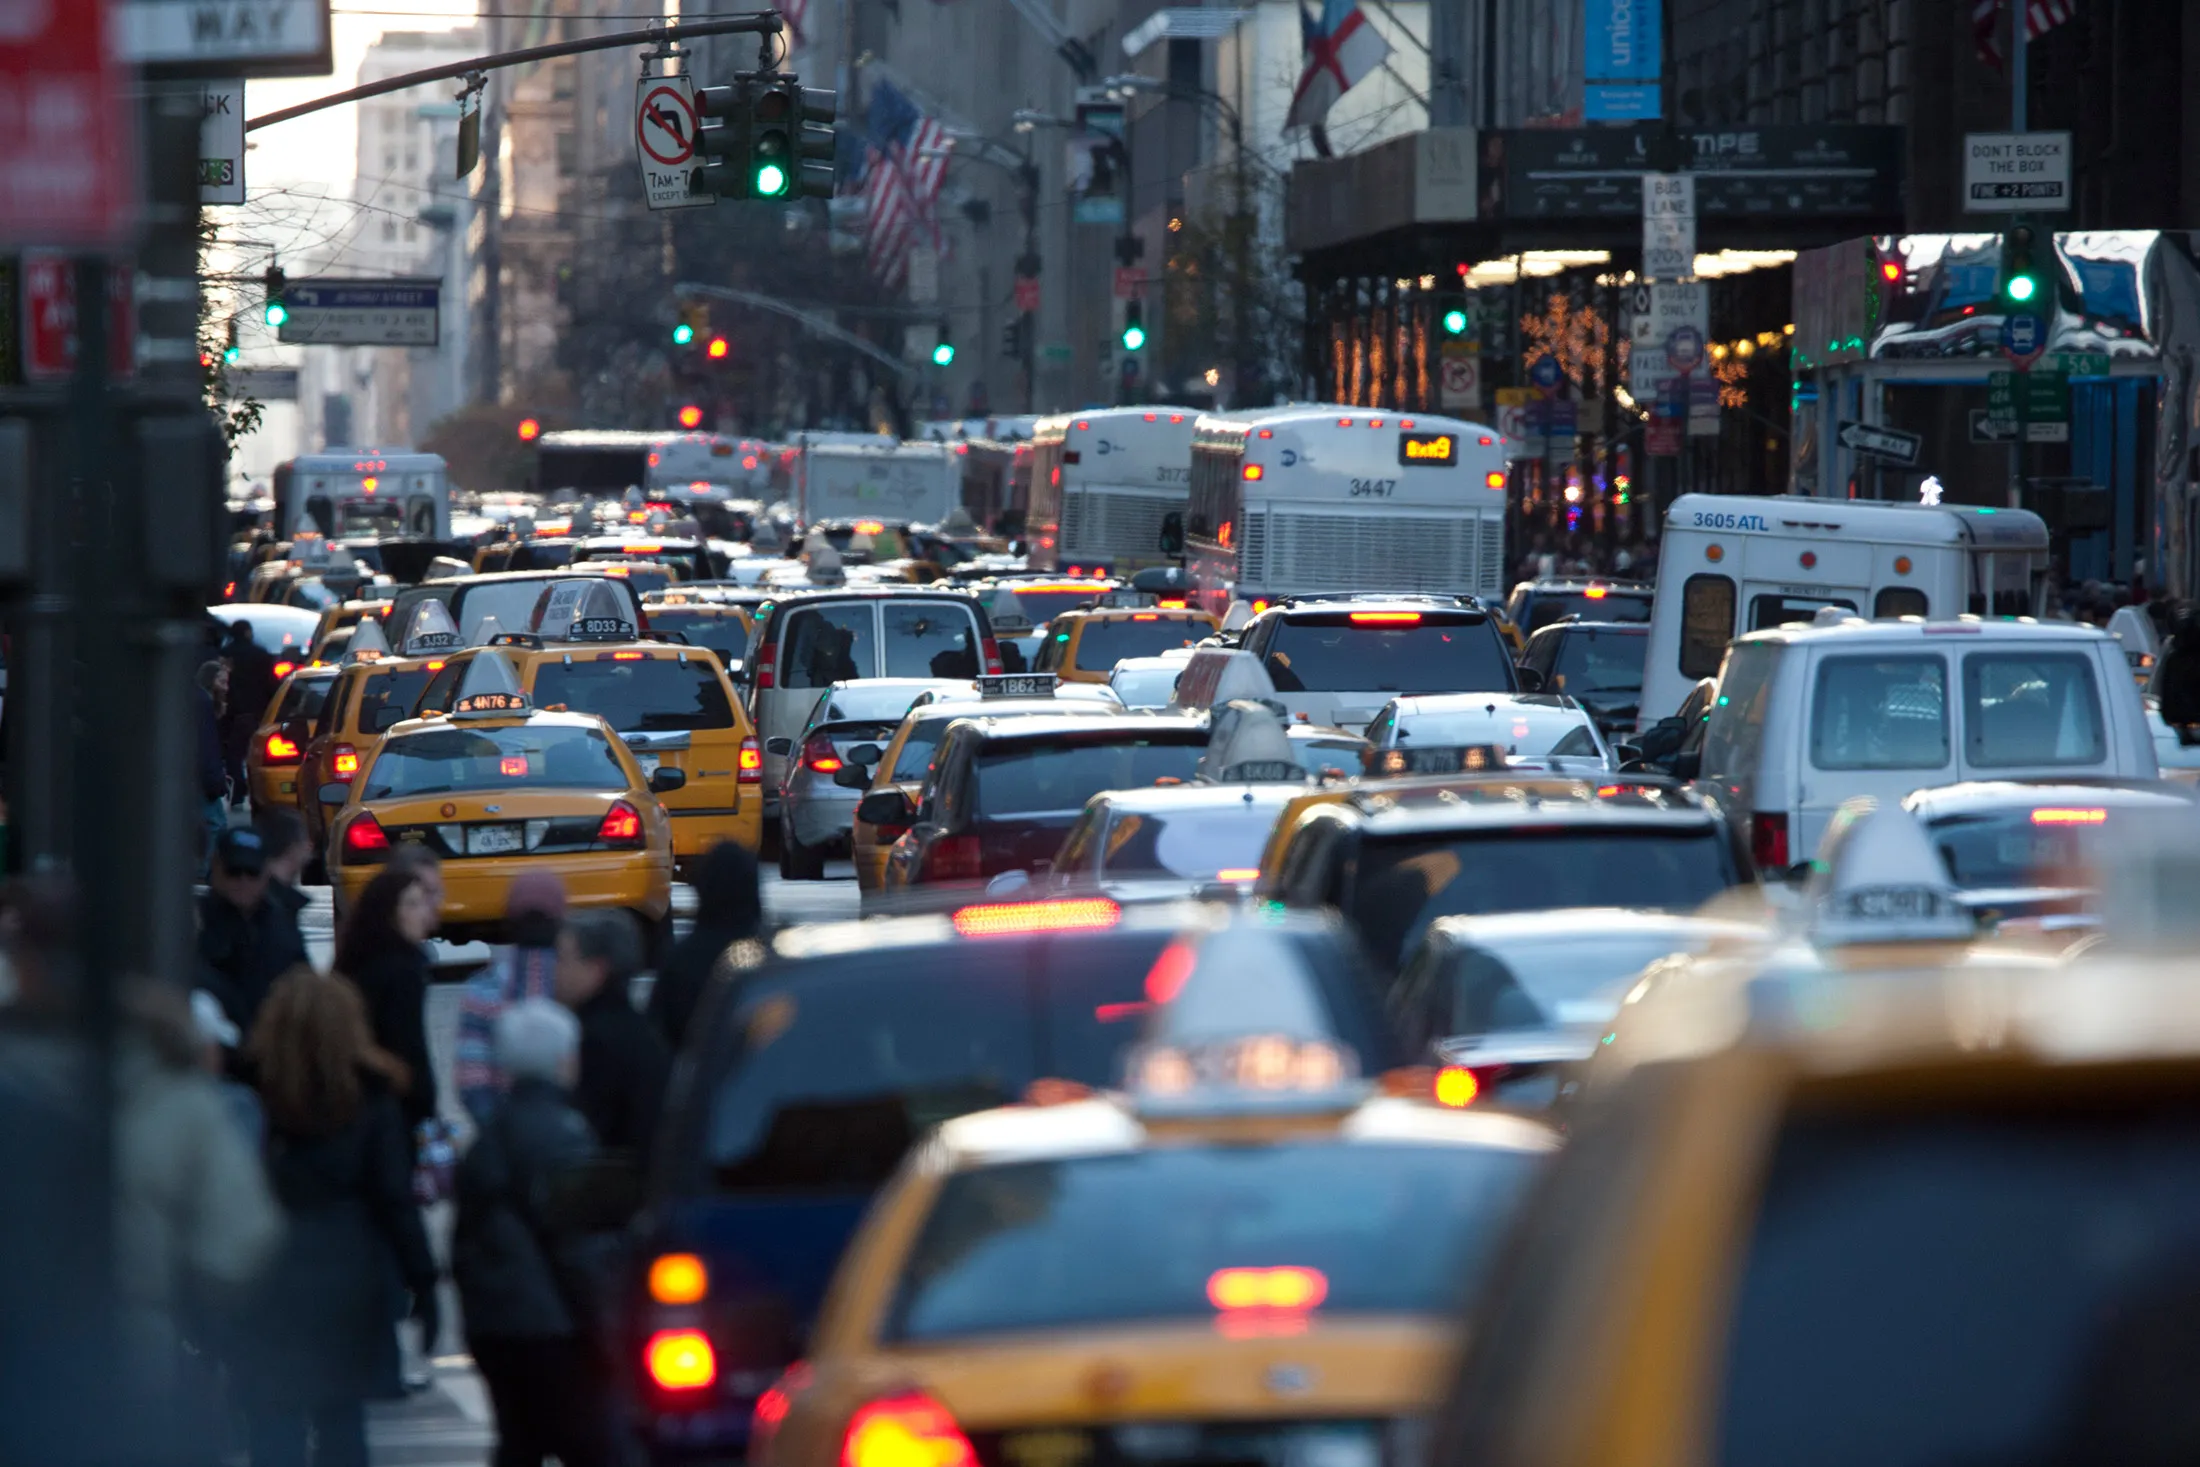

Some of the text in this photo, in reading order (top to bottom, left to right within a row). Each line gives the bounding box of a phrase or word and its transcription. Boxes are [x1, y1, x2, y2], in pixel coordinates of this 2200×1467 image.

[188, 4, 289, 42] WAY
[1605, 0, 1631, 66] unice
[2016, 143, 2062, 156] BLOCK
[1989, 161, 2045, 173] THE BOX
[1655, 181, 1683, 195] BUS
[652, 190, 680, 201] EXCEPT
[1650, 200, 1686, 215] LANE
[1659, 304, 1698, 316] ONLY
[2068, 354, 2092, 375] 56
[1157, 466, 1190, 482] 3173
[1350, 478, 1396, 498] 3447
[586, 620, 617, 633] 8D33
[423, 634, 449, 647] 3J32
[473, 695, 507, 709] 4N76
